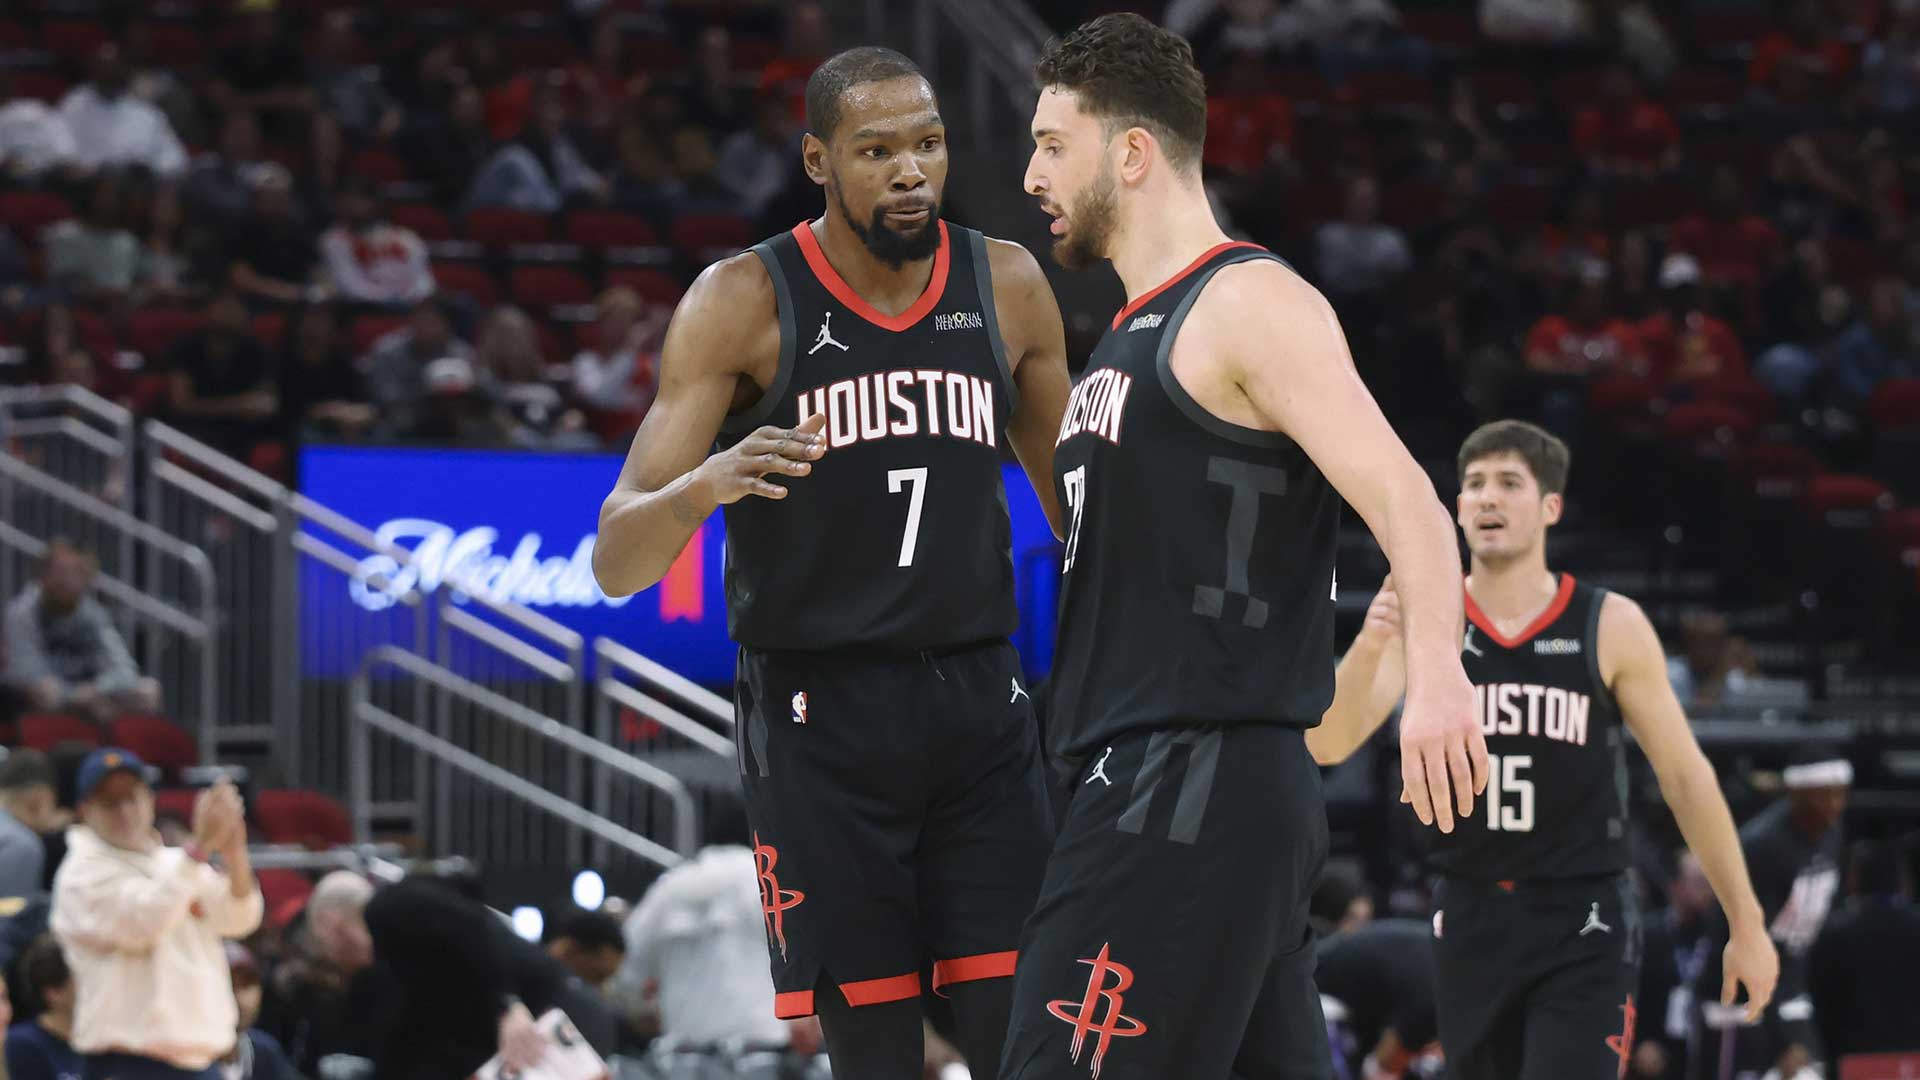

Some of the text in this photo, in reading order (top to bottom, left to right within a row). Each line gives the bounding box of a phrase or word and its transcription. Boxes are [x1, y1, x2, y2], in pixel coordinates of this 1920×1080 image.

[935, 311, 982, 322] MEMORIAL
[936, 319, 983, 331] HERMANN
[797, 368, 999, 452] HOUSTON
[887, 466, 928, 568] 7
[1476, 682, 1591, 747] USTON
[1486, 752, 1536, 833] 15
